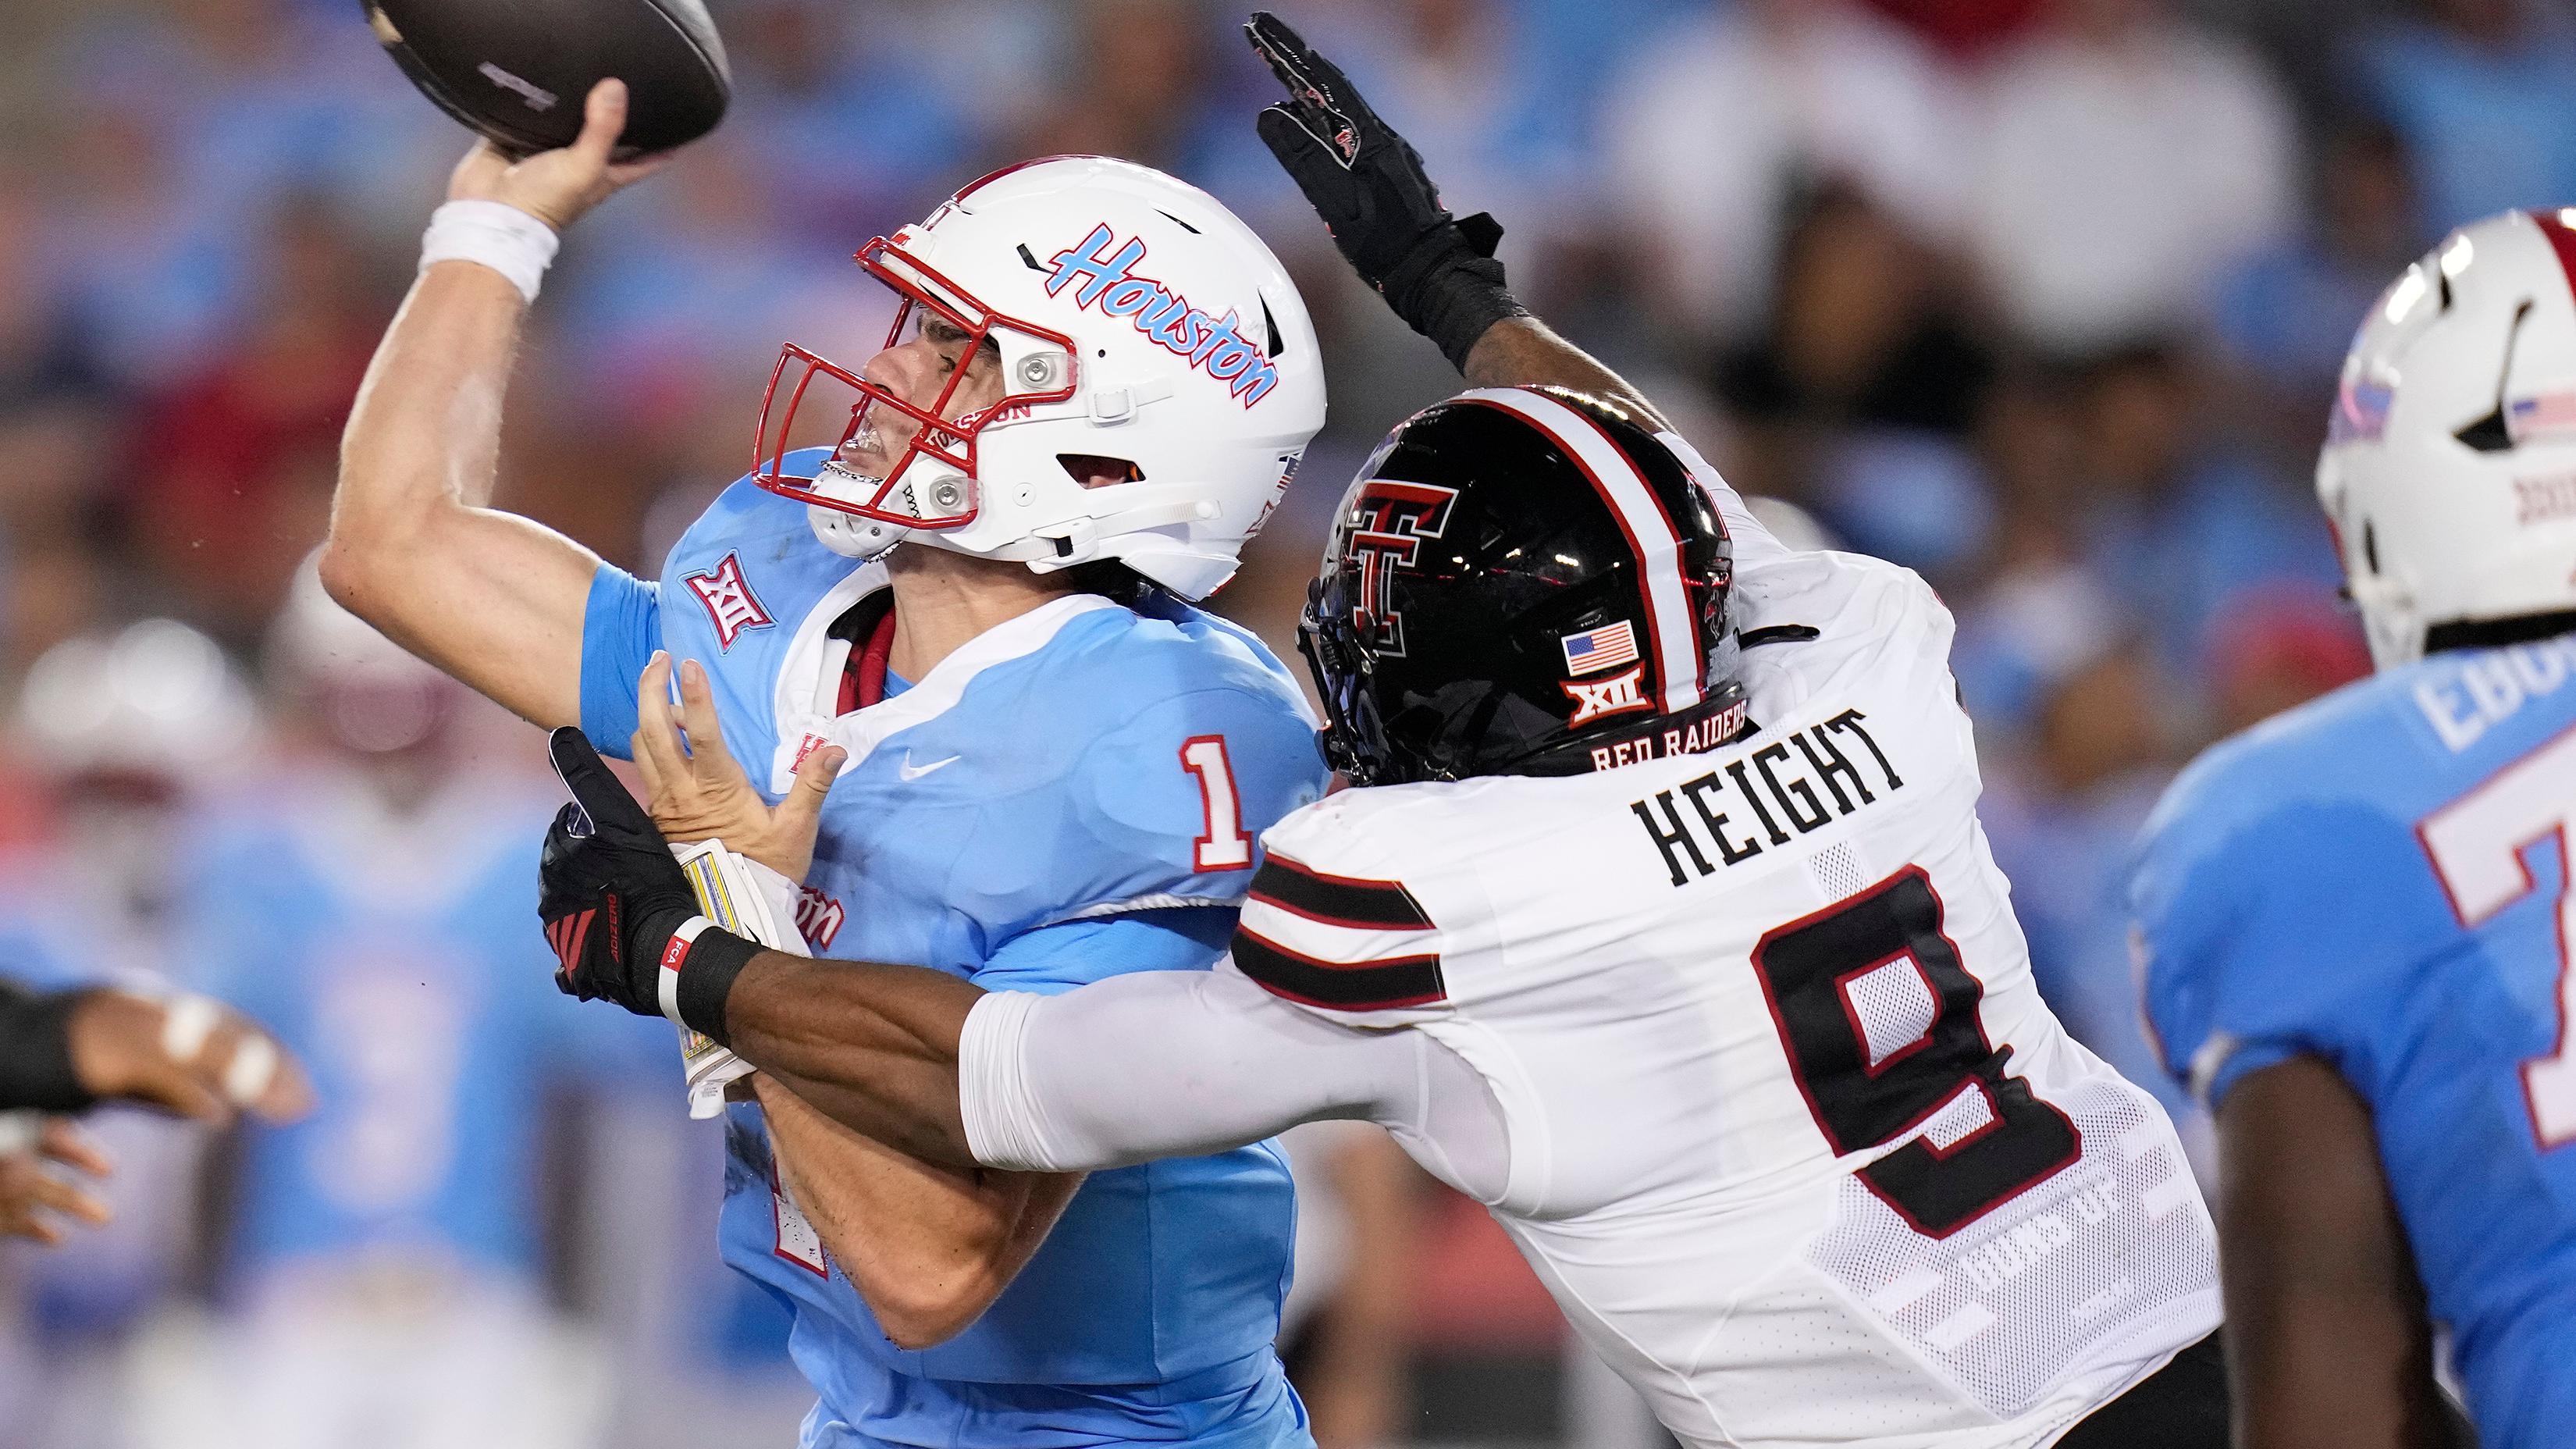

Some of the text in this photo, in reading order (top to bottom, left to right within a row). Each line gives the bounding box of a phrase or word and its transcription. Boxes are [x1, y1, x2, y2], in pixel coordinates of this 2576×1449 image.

[1045, 223, 1278, 410] Houston
[688, 557, 768, 646] XII
[1563, 664, 1651, 727] XII
[1591, 698, 1749, 772] RED RAIDERS
[1178, 734, 1254, 874] 1
[1629, 707, 1905, 888] HEIGHT
[606, 892, 621, 963] ADIZERO
[667, 940, 684, 964] FCA
[1750, 862, 2083, 1241] 9
